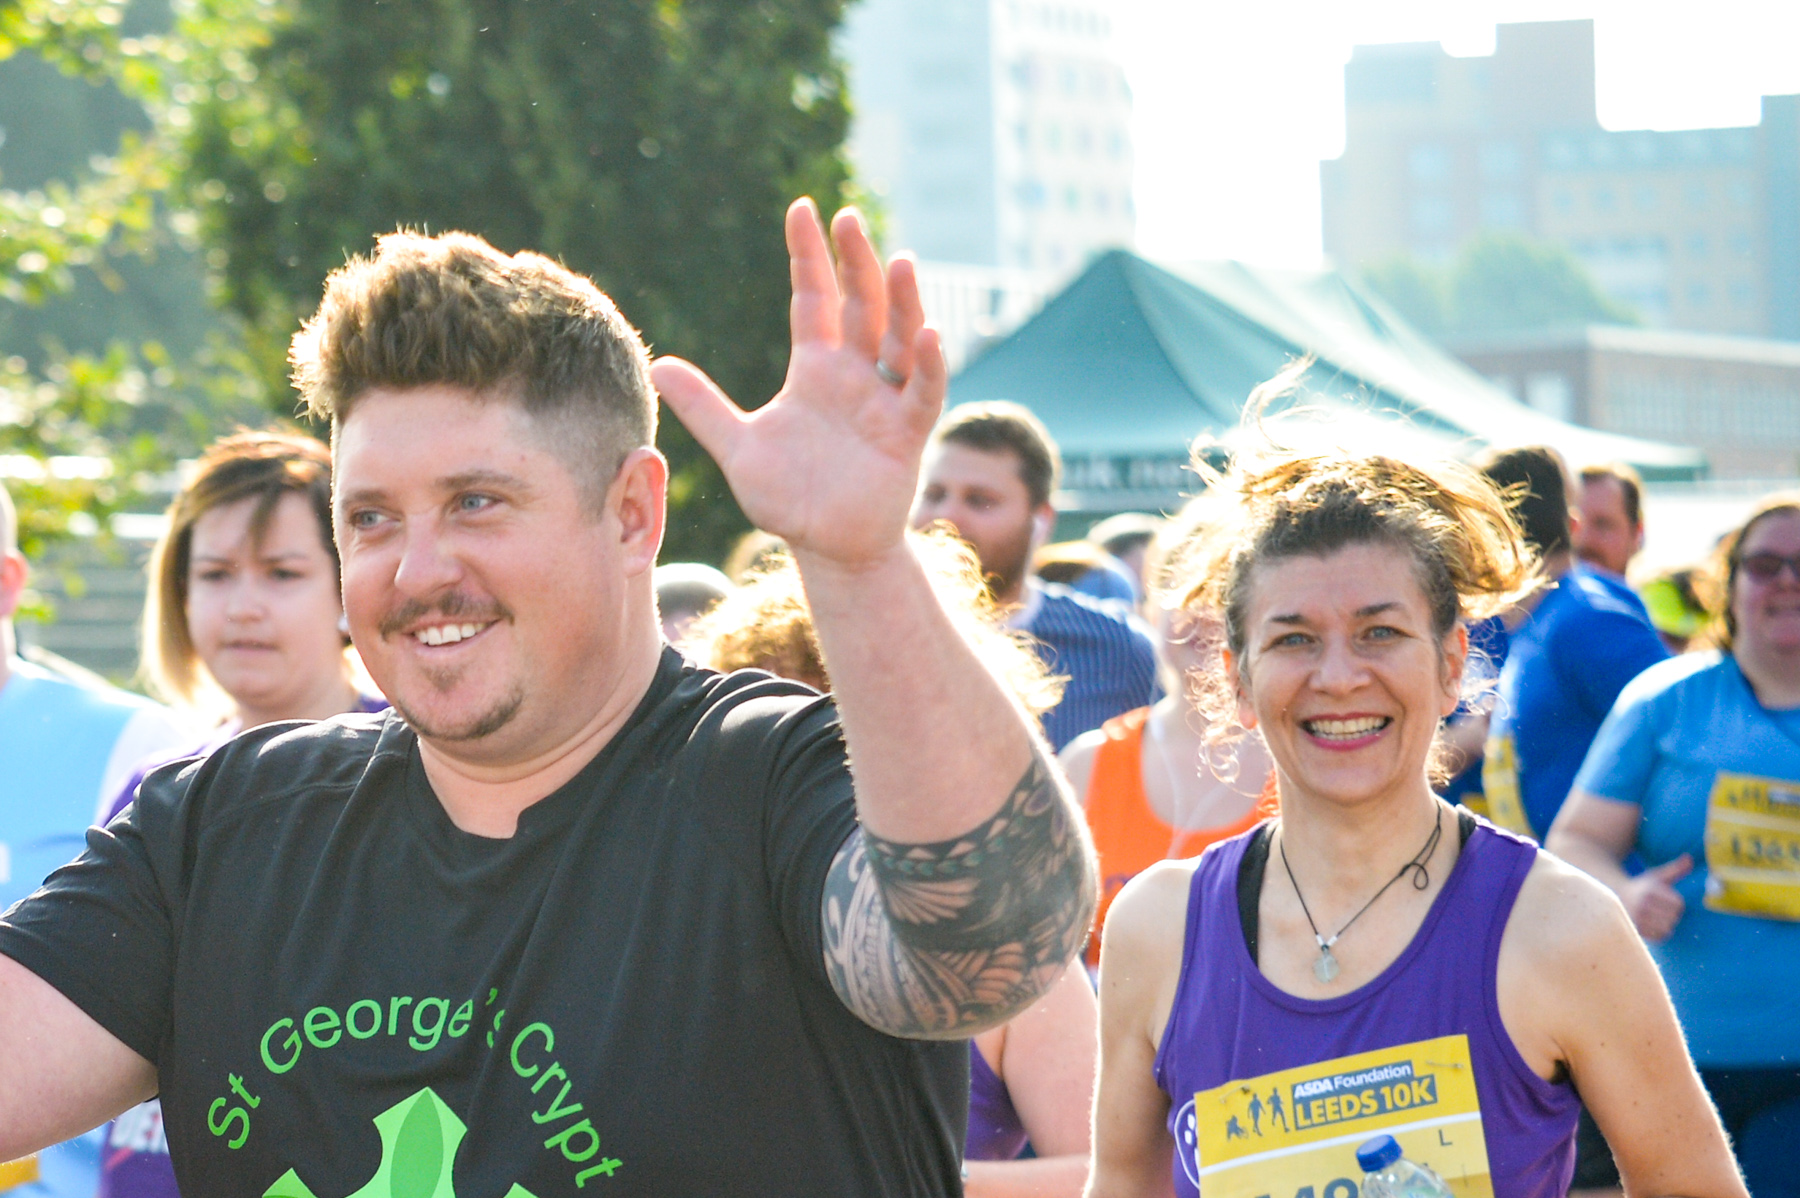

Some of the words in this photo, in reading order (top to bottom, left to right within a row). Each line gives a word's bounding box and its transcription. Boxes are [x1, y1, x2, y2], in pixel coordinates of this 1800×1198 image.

[1293, 1081, 1334, 1100] ASDA
[1334, 1064, 1412, 1090] Foundation
[1294, 1089, 1379, 1128] LEEDS
[1379, 1077, 1435, 1112] 10K
[207, 1072, 261, 1150] St
[509, 1022, 624, 1188] Crypt
[1438, 1128, 1453, 1147] L
